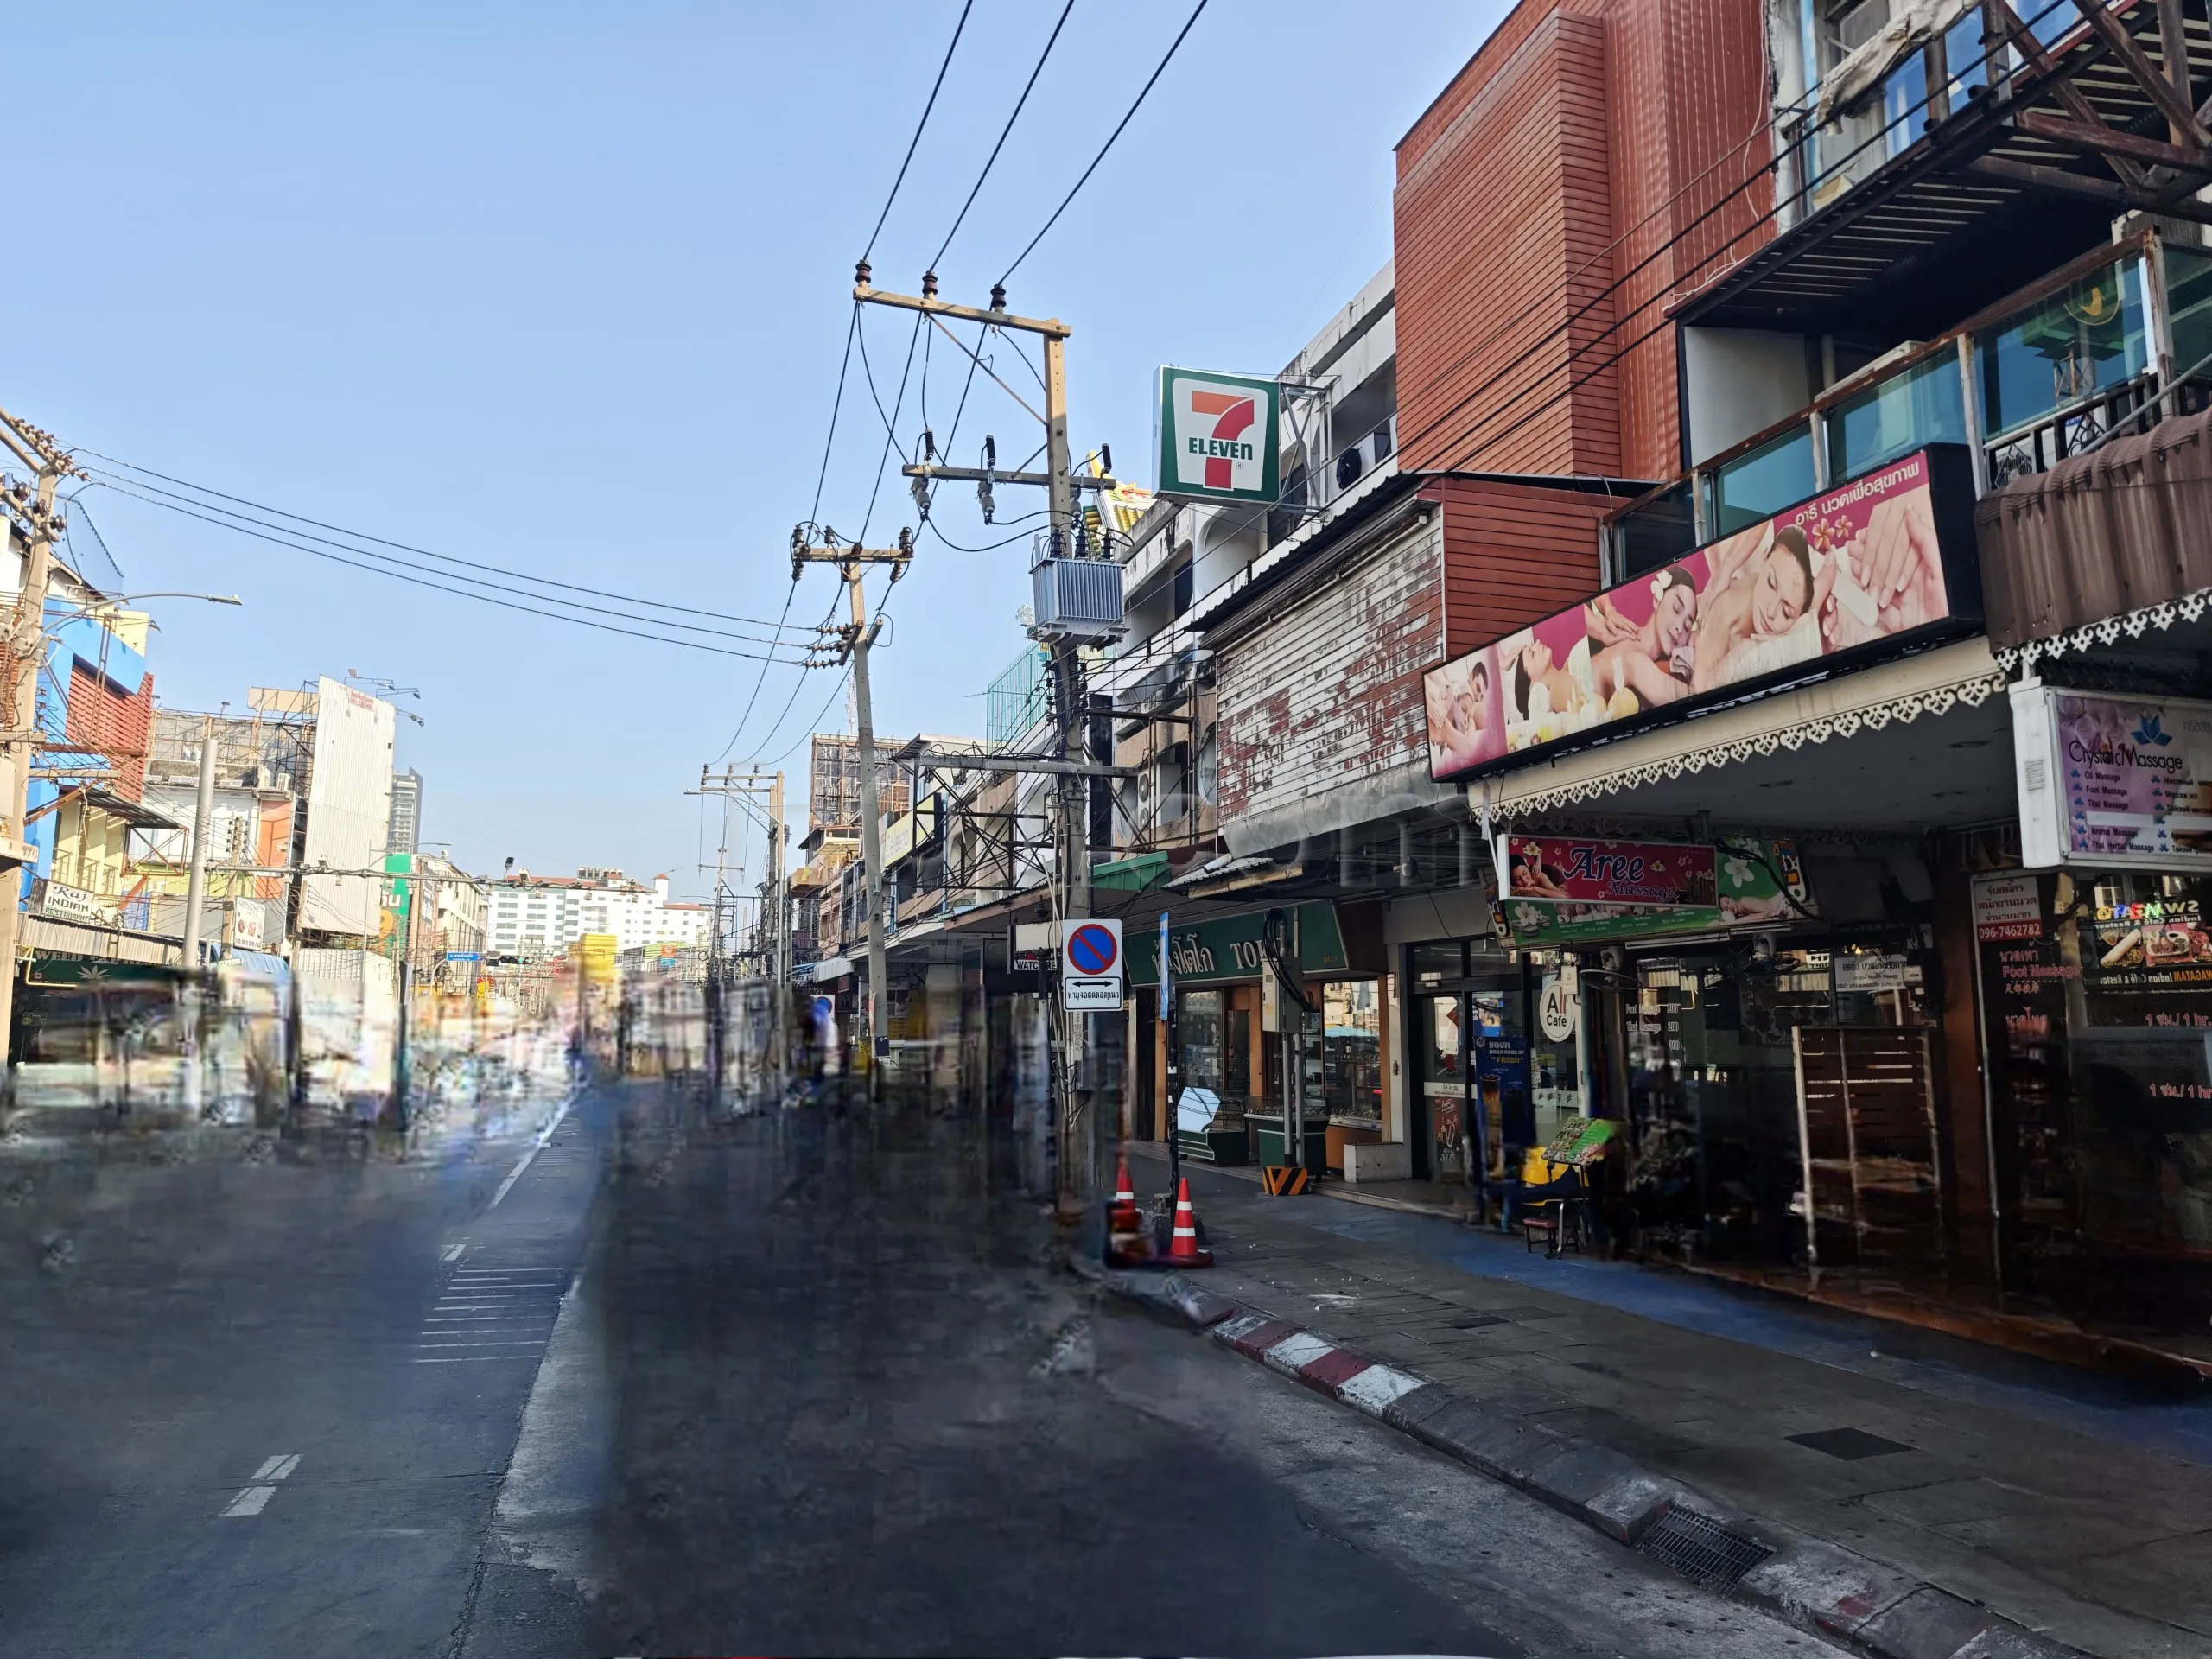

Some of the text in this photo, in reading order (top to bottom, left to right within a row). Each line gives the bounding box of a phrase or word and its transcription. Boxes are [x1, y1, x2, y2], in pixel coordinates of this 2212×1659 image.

[1192, 390, 1255, 489] 7
[1795, 461, 1920, 526] อารี นวดเพื่อสุขภาพ
[2069, 740, 2183, 774] Crystal Massage
[2084, 771, 2121, 783] Oil Massage
[2086, 785, 2127, 797] Foot Massage
[2103, 800, 2128, 810] Massage
[2091, 827, 2139, 837] Aroma Massage
[2093, 841, 2155, 854] Thai Herbal Massage
[1562, 844, 1645, 883] Aree
[52, 886, 88, 901] Raj
[1606, 880, 1676, 902] Massage
[1986, 883, 2024, 895] รับสมัคร
[48, 896, 89, 912] INDIAN
[1977, 896, 2037, 910] พนักงานนวด
[45, 907, 89, 922] RESTAURANT
[1986, 912, 2031, 922] จำนวนมาก
[1979, 923, 2042, 939] 096-7462782
[2002, 964, 2081, 980] Foot Massage
[1667, 1003, 1679, 1014] 200
[1546, 1014, 1567, 1027] Café
[1667, 1021, 1680, 1032] 200
[2145, 1012, 2152, 1027] 1
[2149, 1083, 2157, 1097] 1
